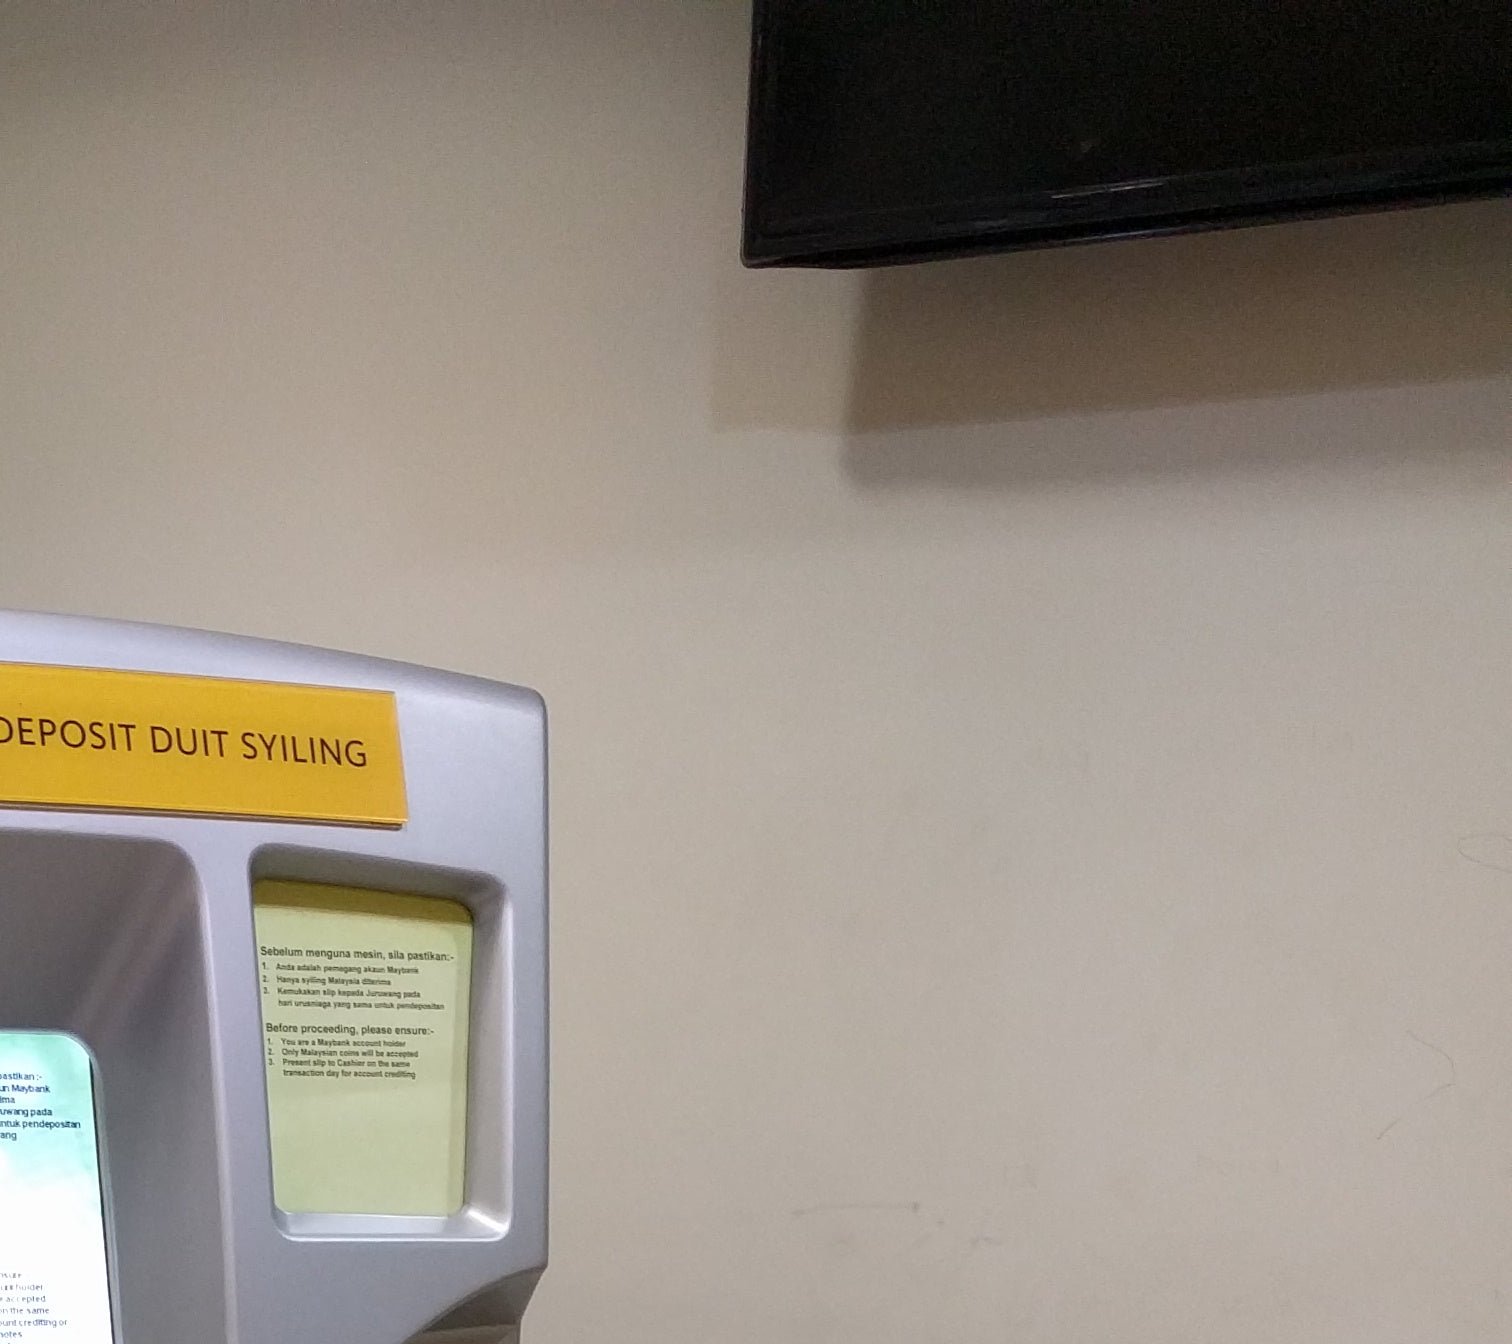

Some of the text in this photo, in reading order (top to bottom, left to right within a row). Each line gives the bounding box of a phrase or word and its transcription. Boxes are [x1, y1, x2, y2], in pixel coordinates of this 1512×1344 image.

[151, 726, 228, 759] DUIT
[241, 732, 367, 768] SYILING
[261, 946, 303, 956] Sebelum
[306, 949, 351, 960] menguna
[354, 950, 385, 960] mesin,
[388, 951, 404, 960] sila
[277, 976, 299, 984] Hanya
[328, 977, 359, 986] Malaysia
[323, 989, 336, 997] slip
[266, 1023, 298, 1033] Before
[301, 1025, 358, 1036] proceeding,
[362, 1026, 392, 1036] please
[317, 1039, 349, 1047] Maybank
[282, 1049, 298, 1057] Only
[301, 1049, 337, 1057] Malaysian
[313, 1060, 326, 1068] slip
[326, 1070, 339, 1078] day
[12, 1085, 50, 1094] Maybank
[31, 1108, 52, 1117] pada
[22, 1120, 80, 1129] pendepositan
